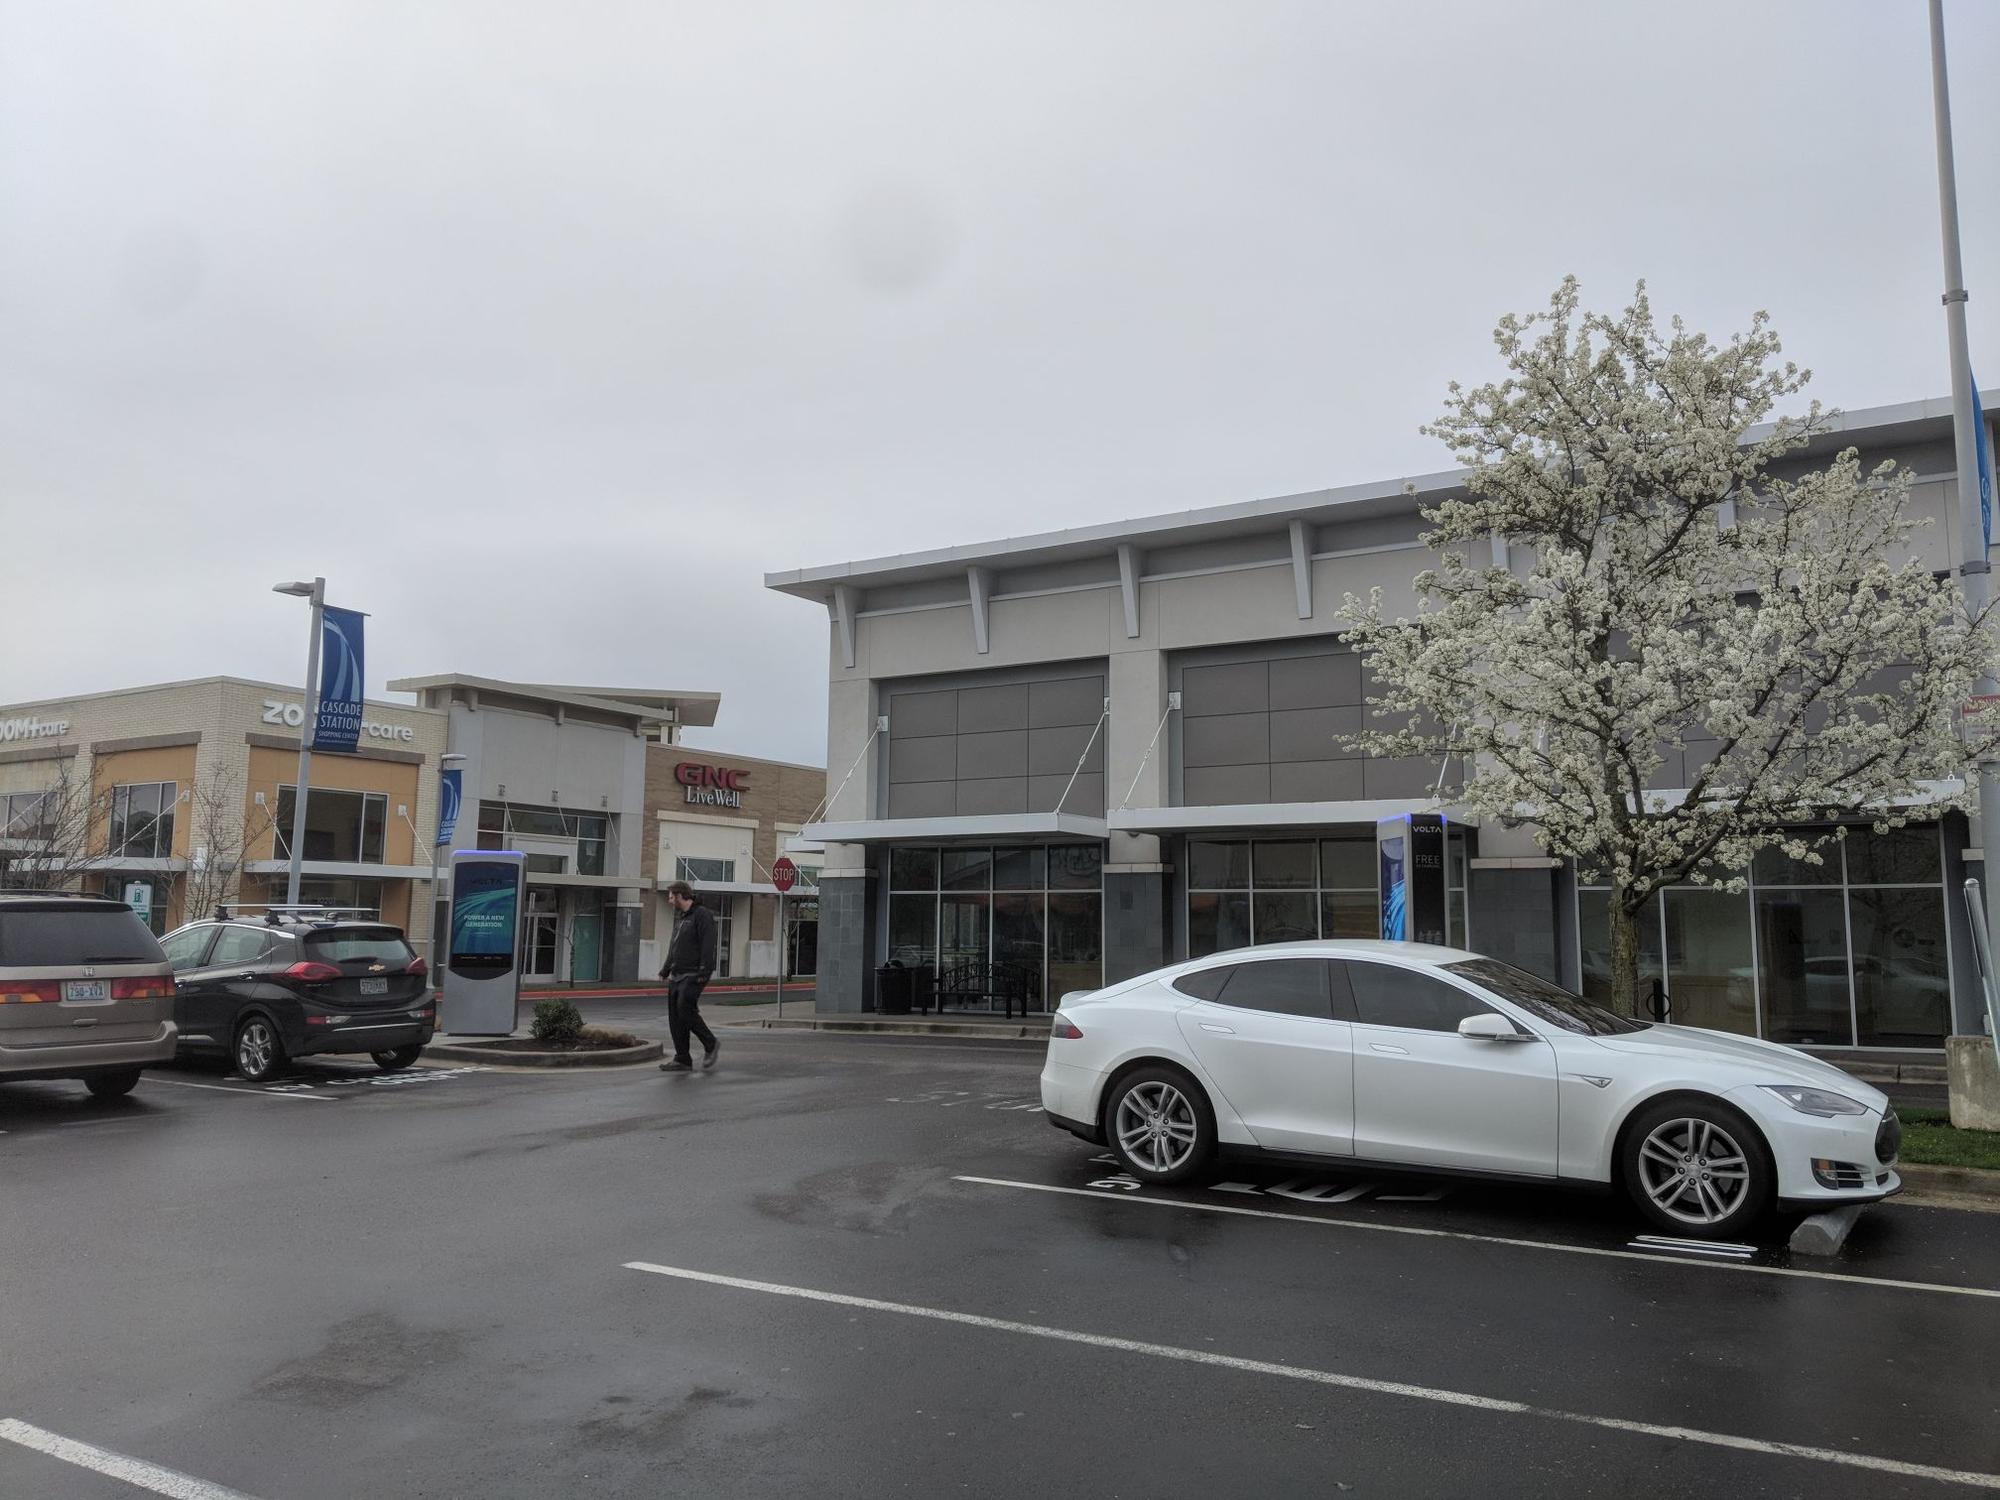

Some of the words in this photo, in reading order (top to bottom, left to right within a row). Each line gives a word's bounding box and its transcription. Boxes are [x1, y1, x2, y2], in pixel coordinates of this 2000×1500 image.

[321, 700, 361, 716] CASCADE
[320, 715, 361, 730] STATION
[675, 762, 751, 792] GNC
[1415, 854, 1440, 864] FREE
[773, 867, 795, 881] STOP
